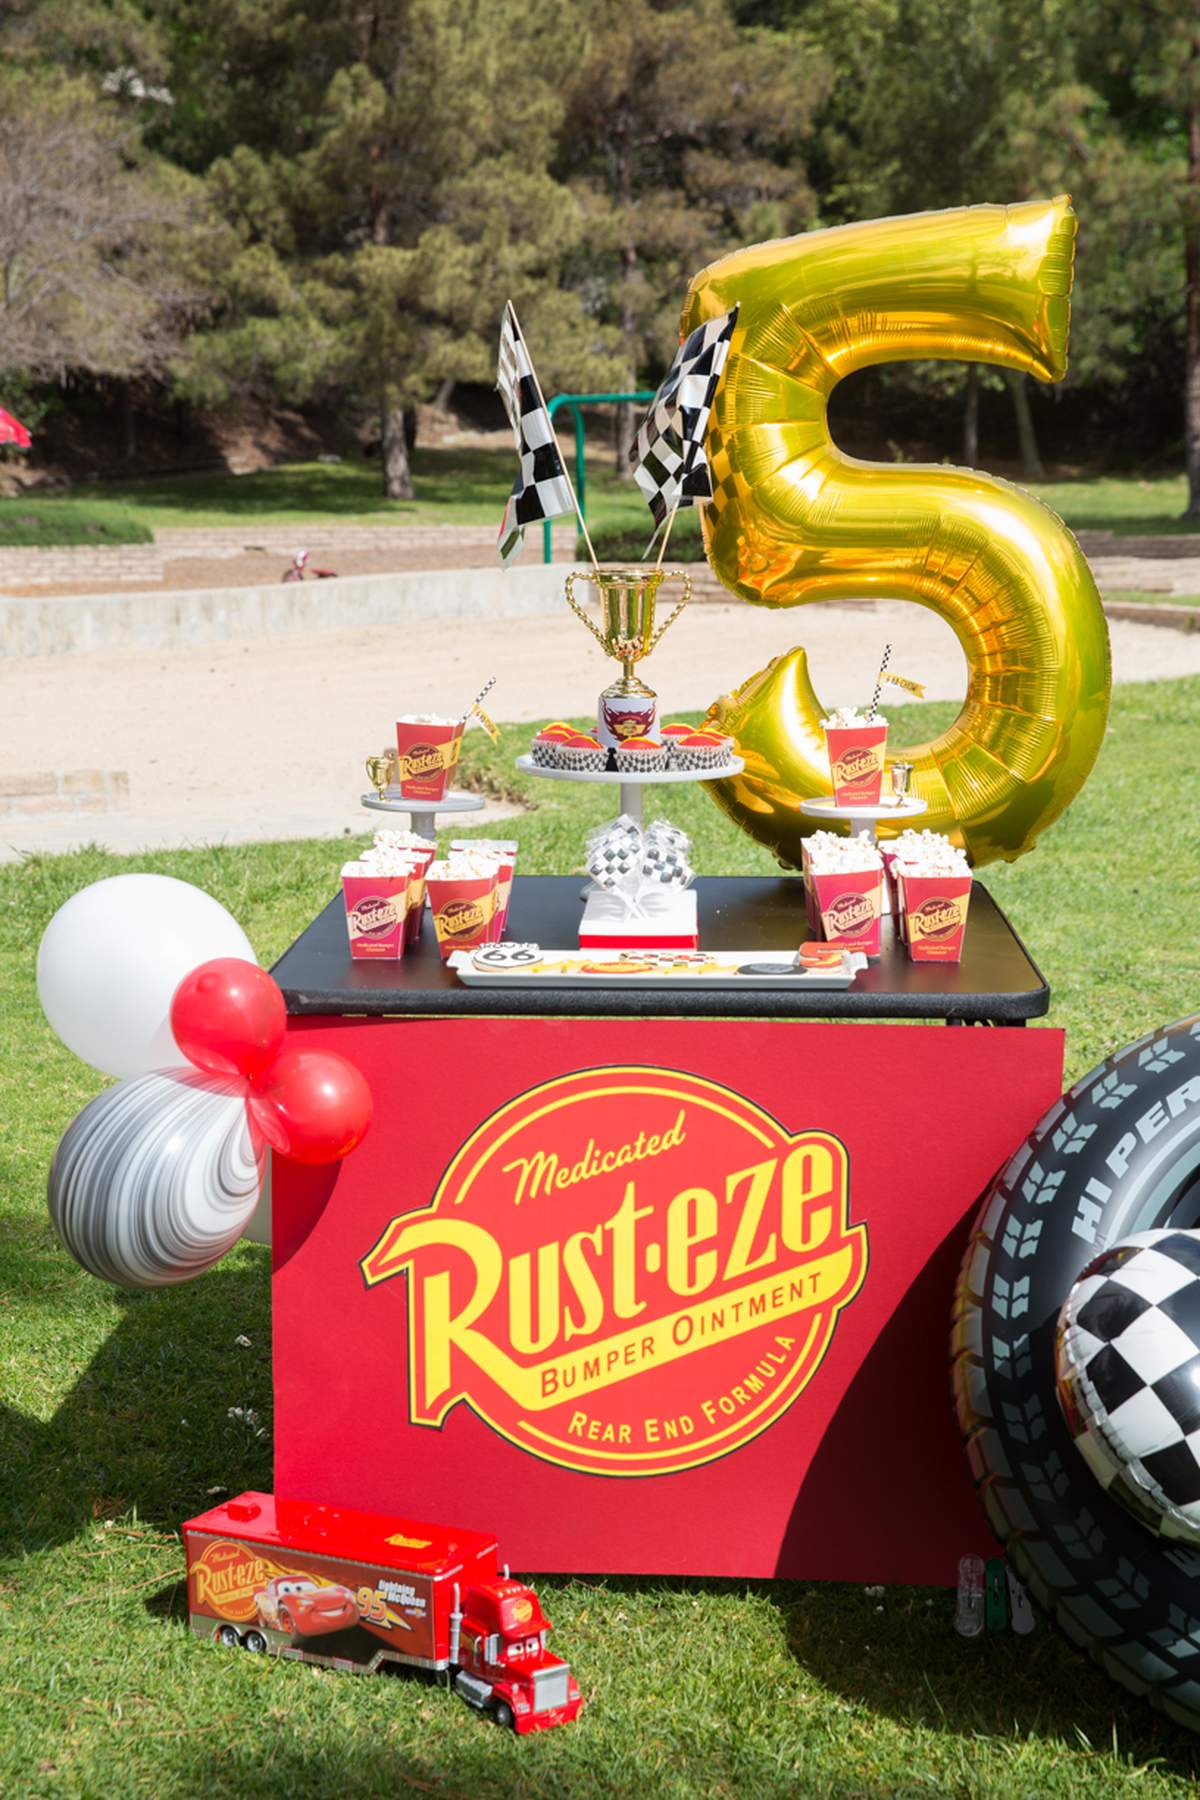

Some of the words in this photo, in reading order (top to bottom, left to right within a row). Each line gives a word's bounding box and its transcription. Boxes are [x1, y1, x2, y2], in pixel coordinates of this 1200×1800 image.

[679, 194, 1112, 868] 5
[483, 950, 535, 961] 66
[502, 1109, 686, 1206] Medicated
[540, 1335, 656, 1399] BUMPER
[672, 1272, 823, 1347] OINTMENT
[568, 1411, 632, 1444] REAR
[645, 1416, 695, 1443] END
[704, 1334, 796, 1425] FORMULA
[357, 1586, 388, 1620] 95
